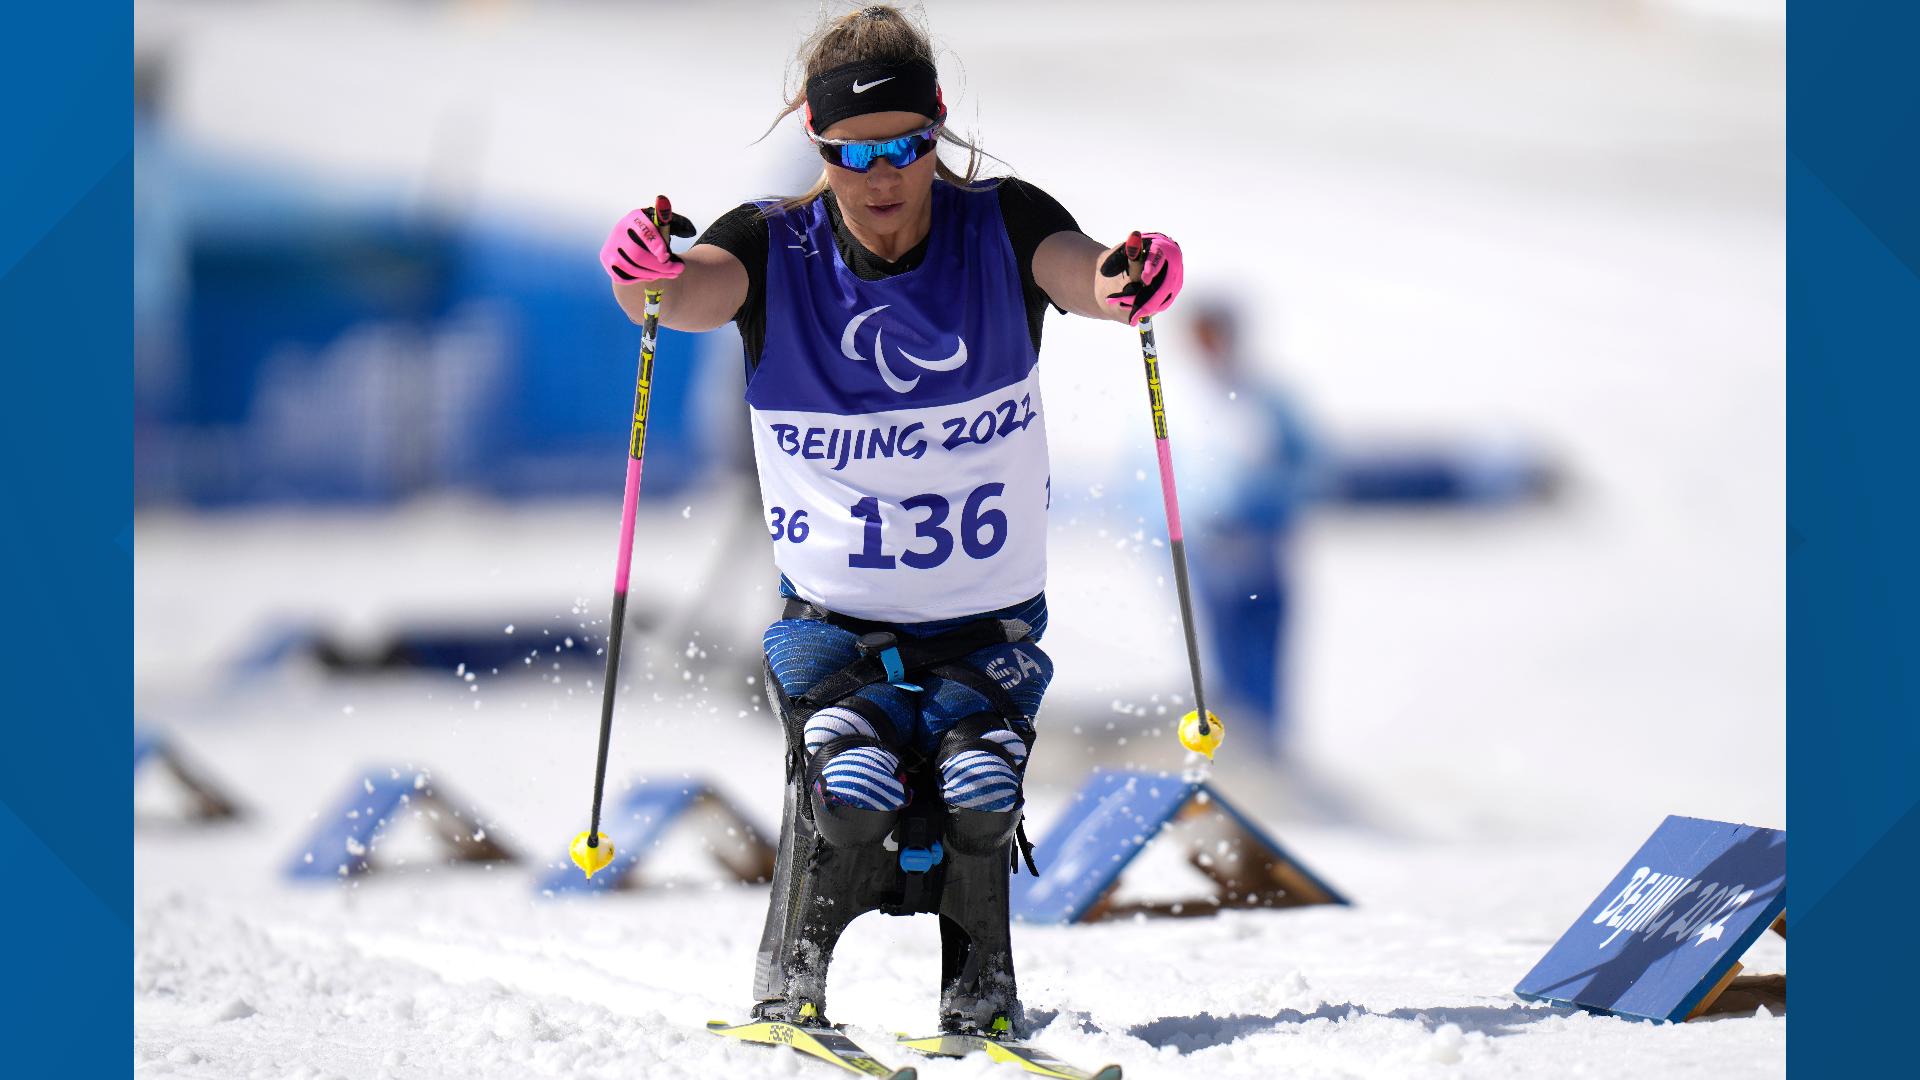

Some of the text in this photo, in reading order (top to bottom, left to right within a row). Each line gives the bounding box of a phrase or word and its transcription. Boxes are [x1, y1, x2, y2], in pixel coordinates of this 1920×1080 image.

[769, 422, 927, 471] BEIJING
[848, 482, 1007, 569] 136
[1592, 866, 1754, 949] BEIJING 2022
